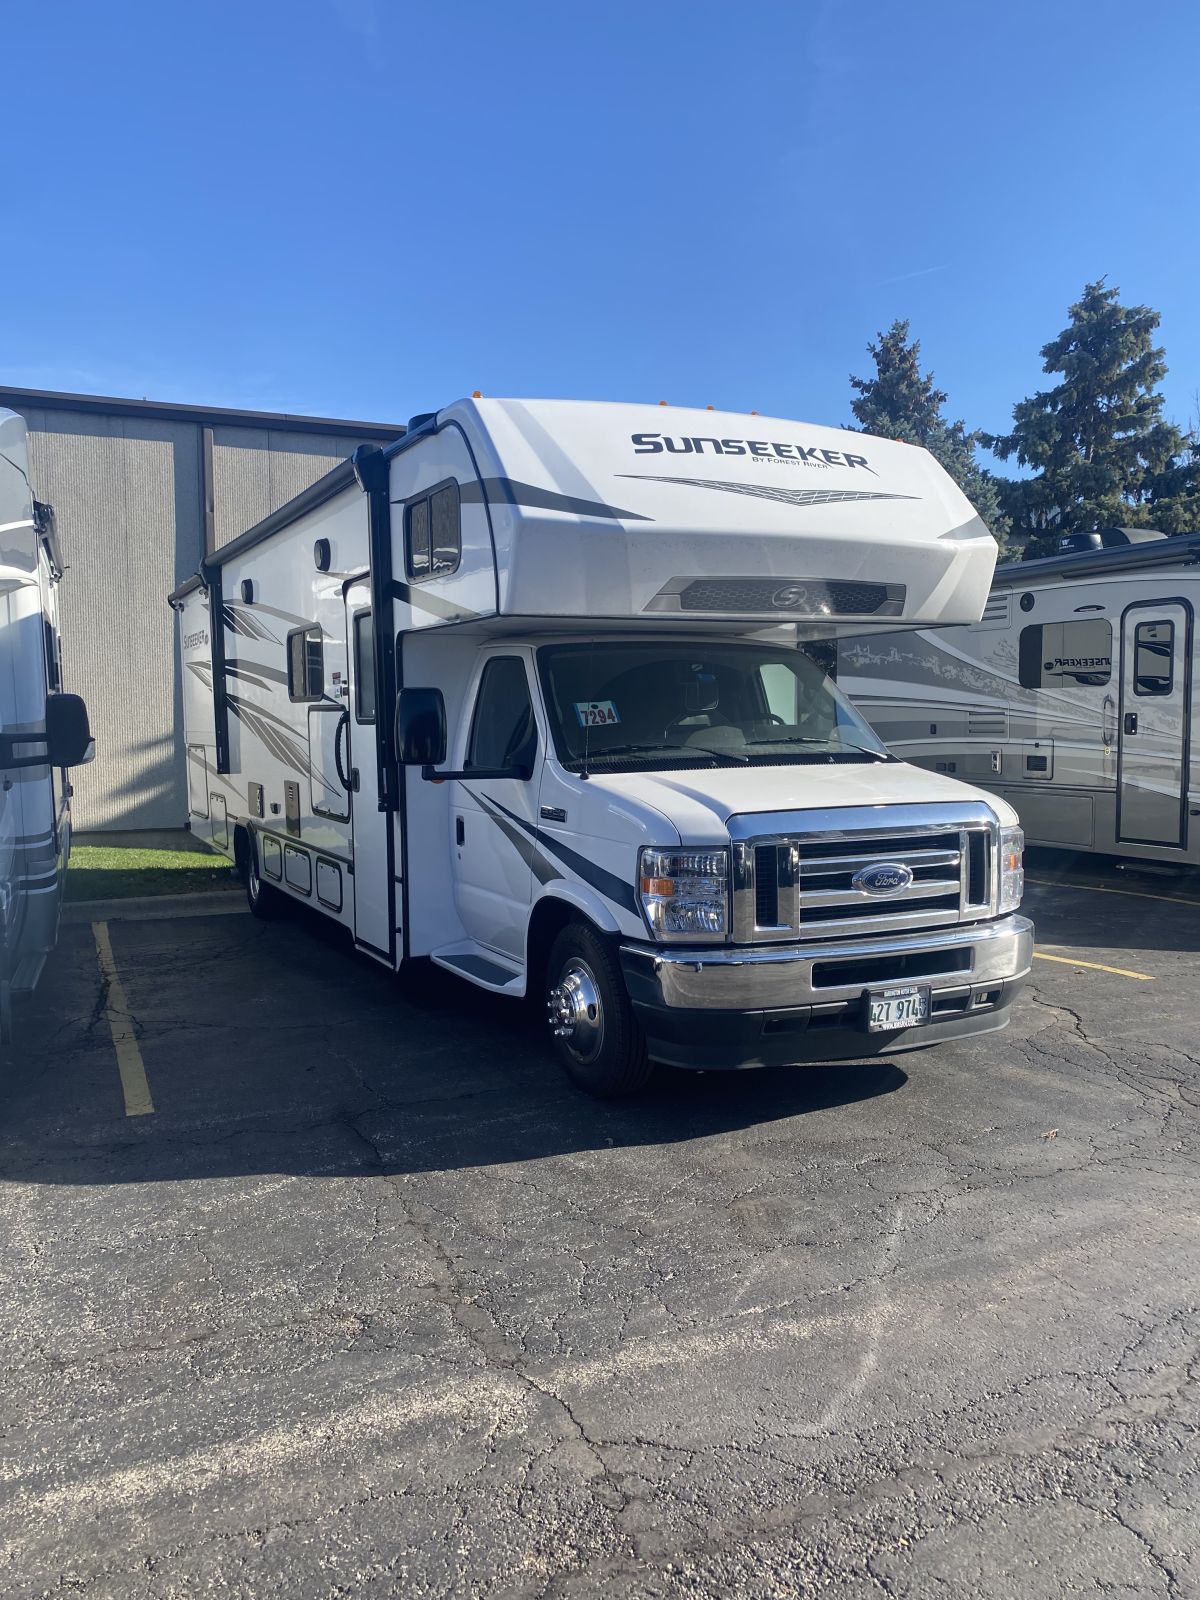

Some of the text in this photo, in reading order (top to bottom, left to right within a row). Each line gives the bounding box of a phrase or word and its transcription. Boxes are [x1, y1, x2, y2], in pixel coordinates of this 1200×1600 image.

[631, 433, 880, 477] SUNSEEKER
[768, 457, 800, 466] FOREST
[803, 461, 828, 469] RIVER
[580, 707, 616, 725] 7294
[875, 872, 899, 886] Ford
[870, 1002, 891, 1023] 427
[896, 998, 918, 1020] 974
